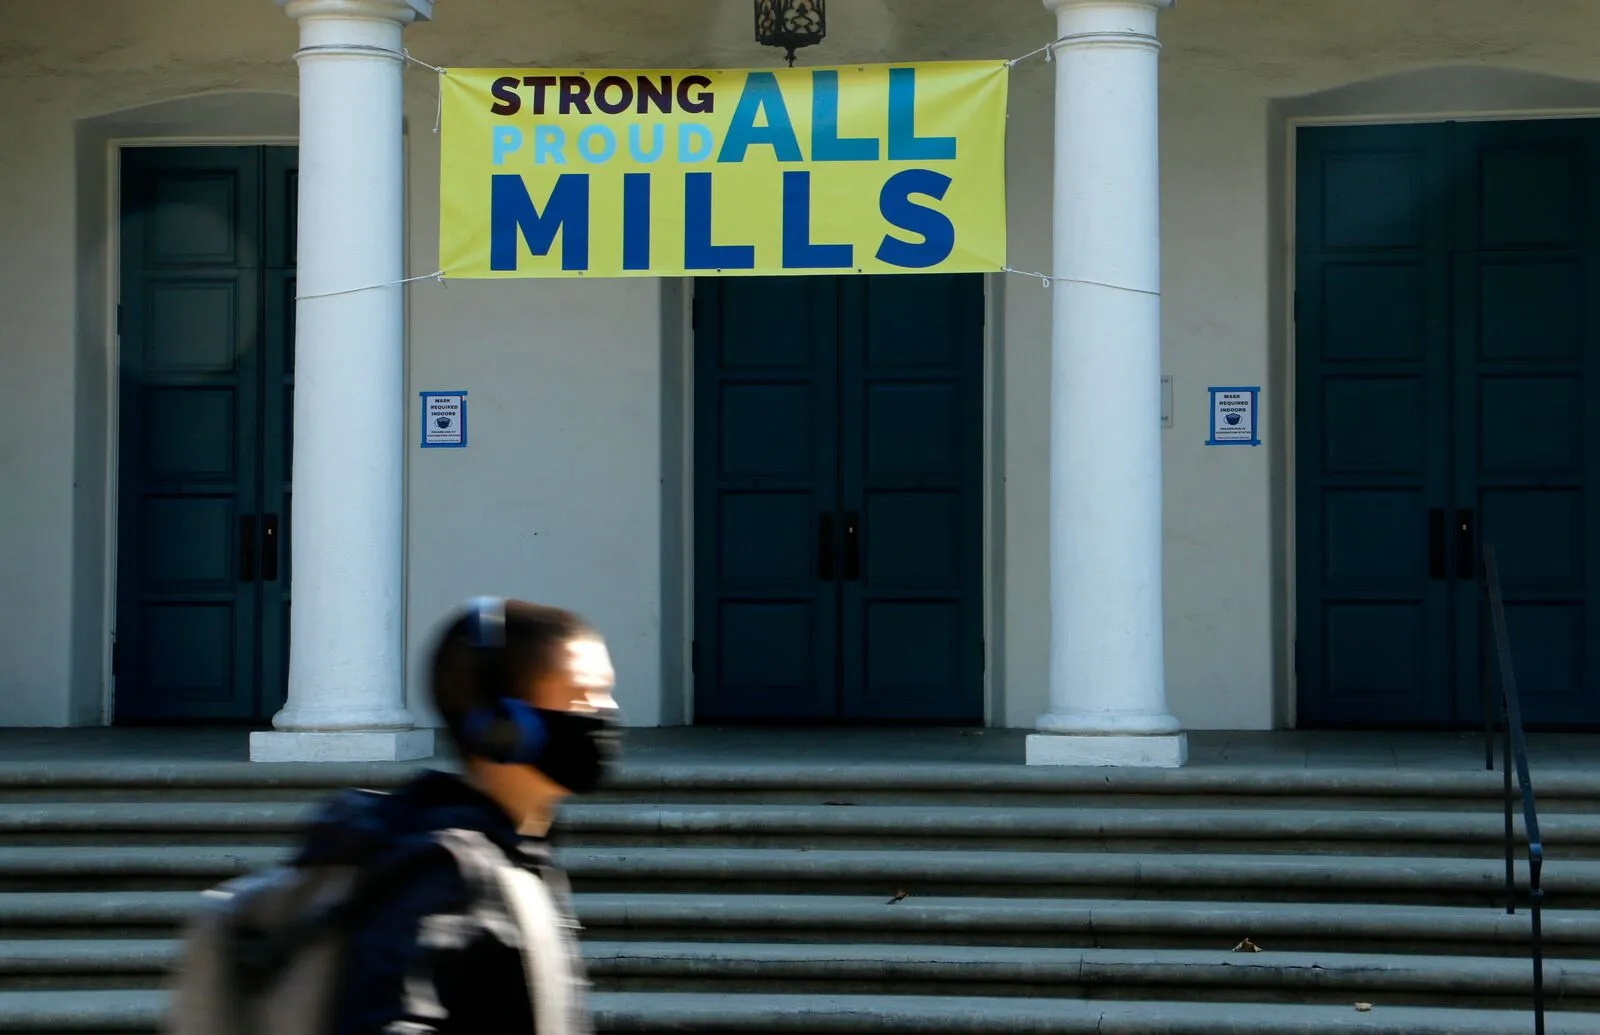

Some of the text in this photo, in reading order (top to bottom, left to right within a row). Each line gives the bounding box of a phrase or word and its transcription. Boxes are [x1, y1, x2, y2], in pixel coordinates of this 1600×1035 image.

[490, 75, 714, 116] STRONG
[717, 67, 957, 163] ALL
[492, 124, 714, 165] PROUD
[490, 168, 956, 271] MILLS
